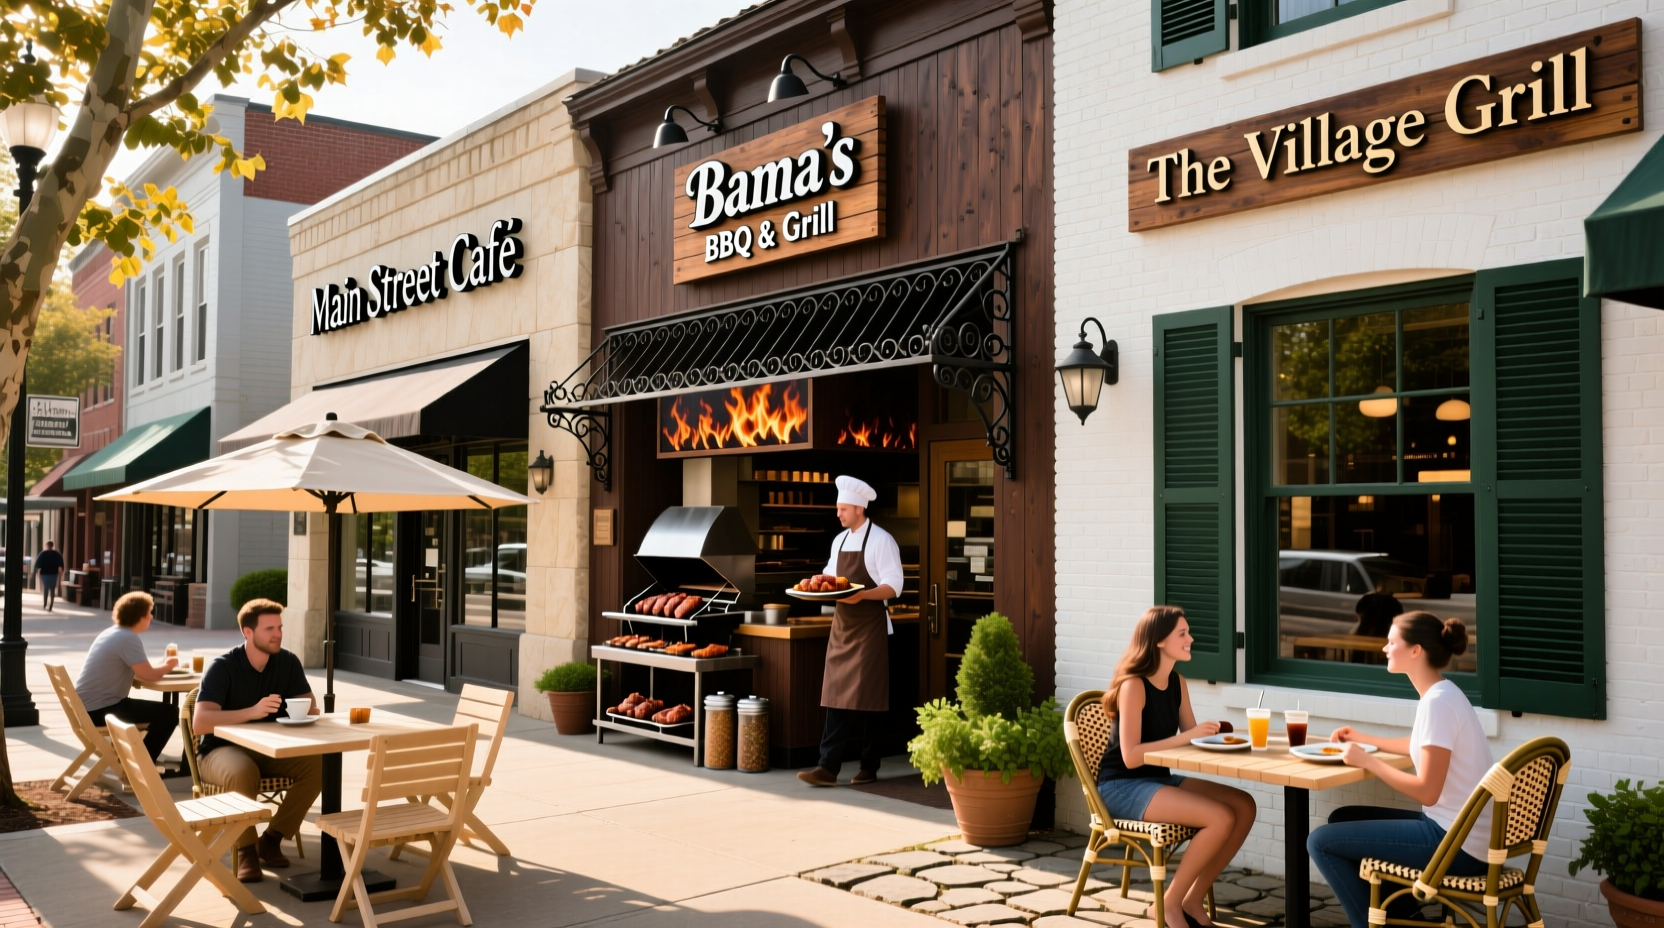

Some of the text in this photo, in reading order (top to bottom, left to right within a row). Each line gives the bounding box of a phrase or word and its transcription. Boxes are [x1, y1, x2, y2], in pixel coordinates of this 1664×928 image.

[685, 121, 856, 229] Bama's
[1147, 46, 1593, 204] The Village Grill
[310, 218, 520, 335] Main Street Café
[705, 200, 835, 263] BBQ & Grill
